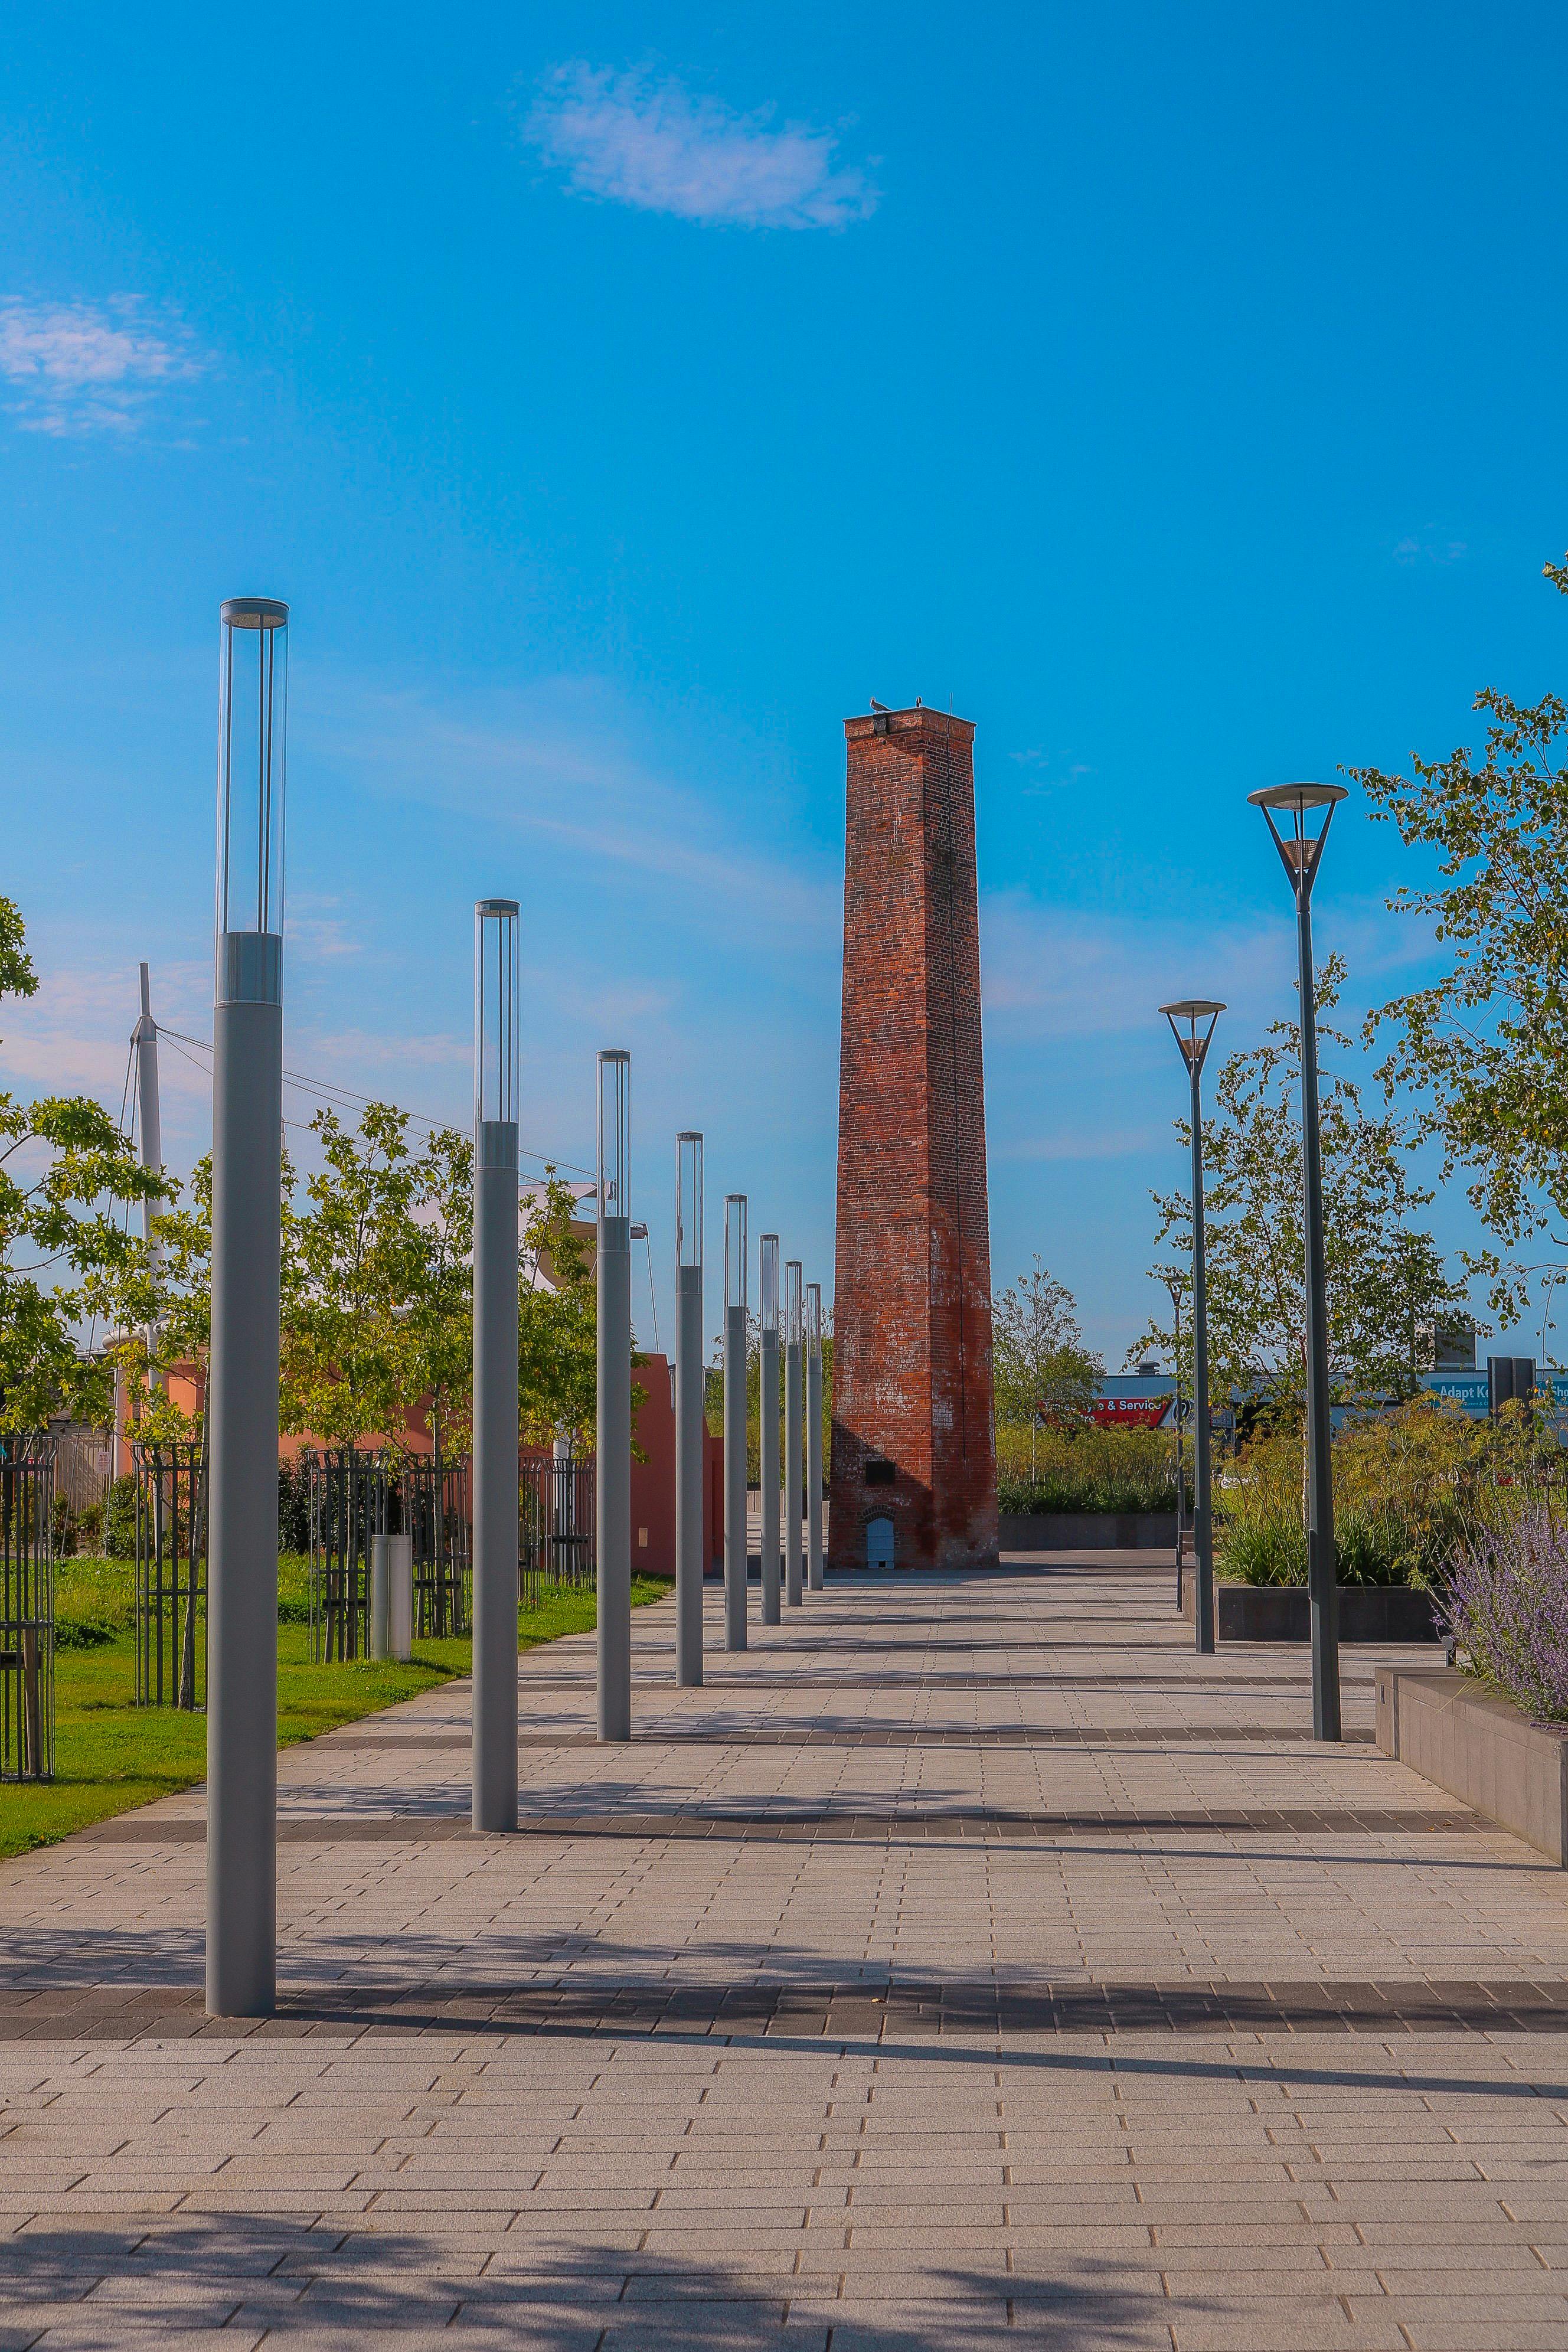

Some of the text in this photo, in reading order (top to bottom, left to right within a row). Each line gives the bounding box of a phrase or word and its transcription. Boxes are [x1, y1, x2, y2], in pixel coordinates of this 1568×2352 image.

[1440, 1386, 1474, 1401] Adapt
[1108, 1400, 1116, 1410] &
[1119, 1400, 1161, 1410] Service
